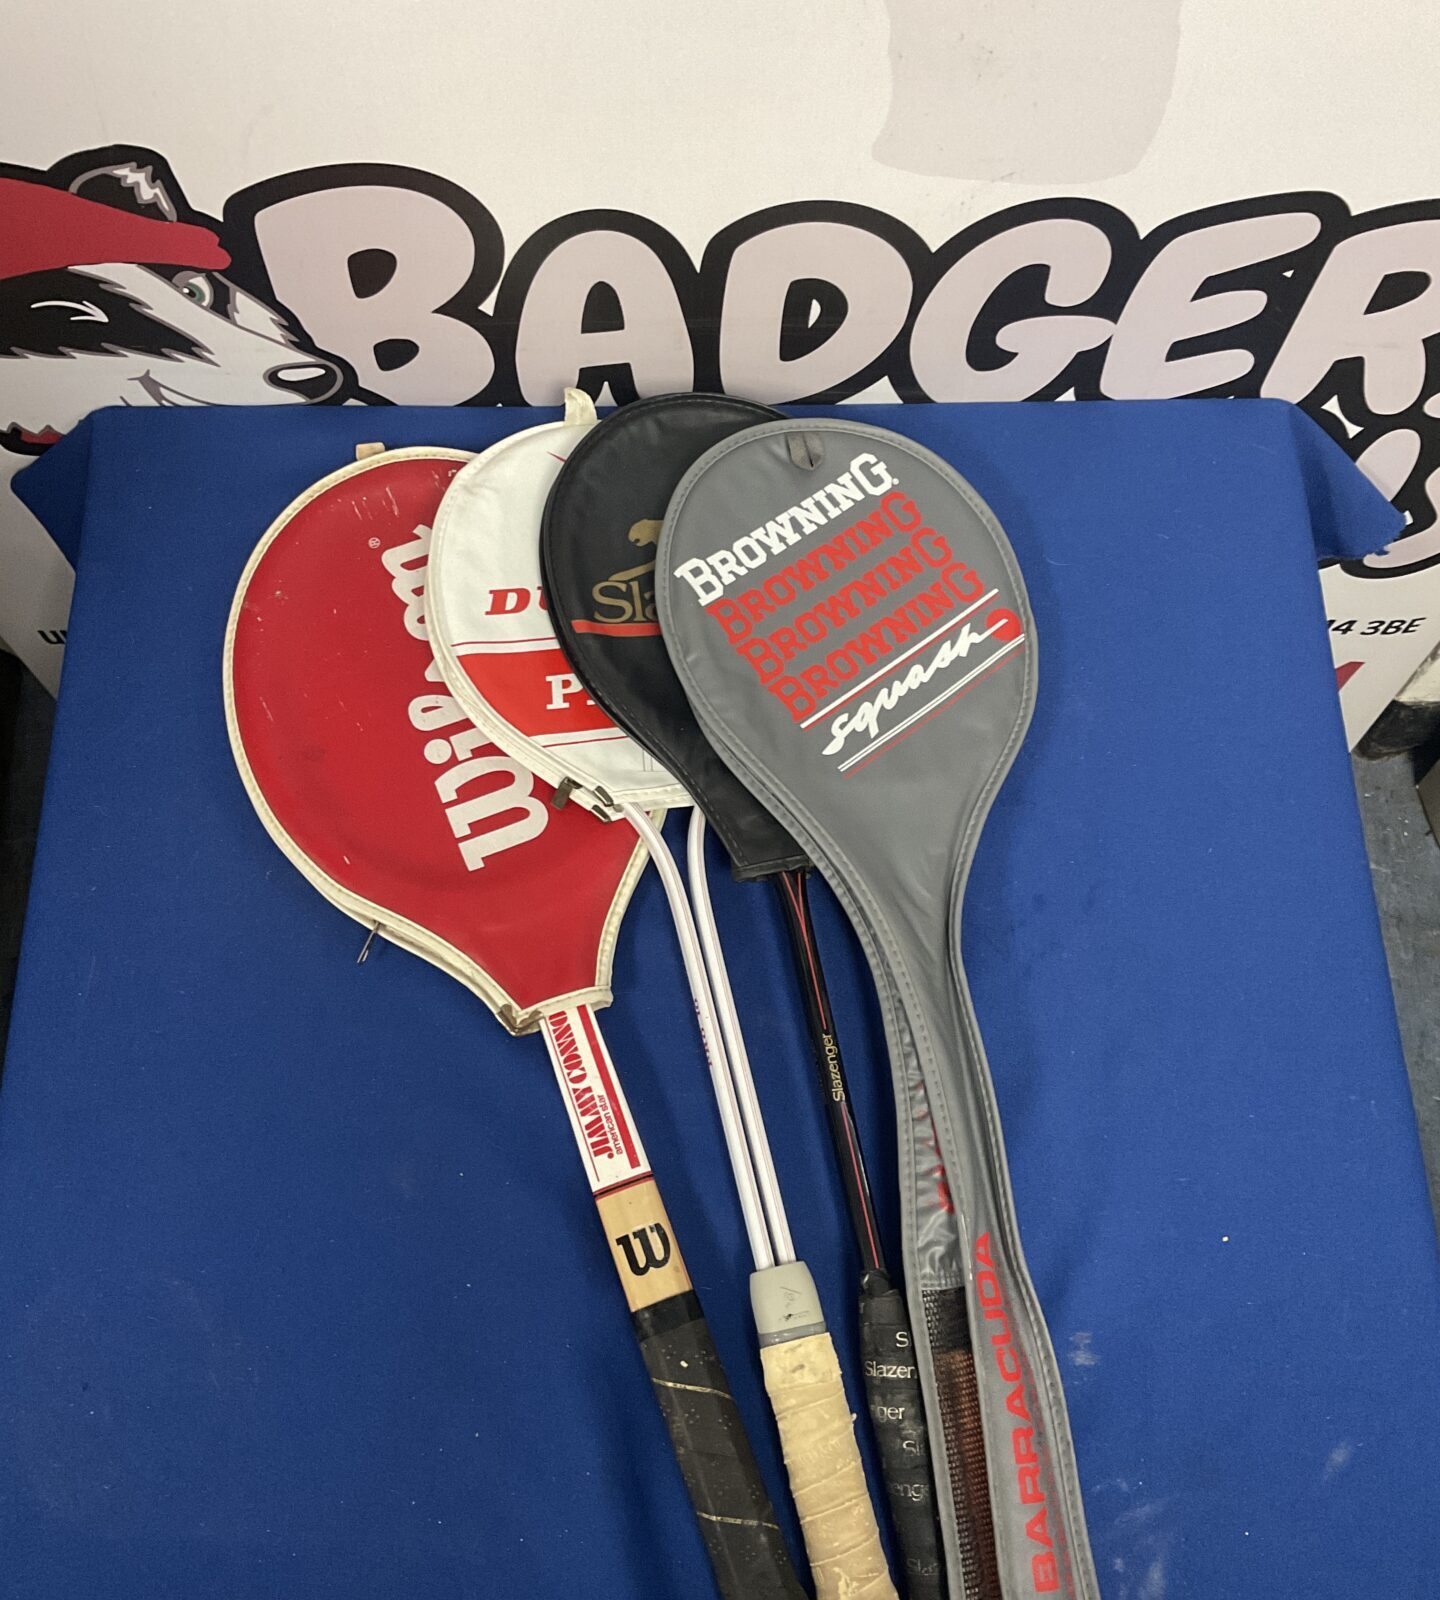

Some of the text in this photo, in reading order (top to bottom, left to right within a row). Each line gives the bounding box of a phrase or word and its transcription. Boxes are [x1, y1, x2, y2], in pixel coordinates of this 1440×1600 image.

[246, 175, 1440, 415] BADGER
[704, 491, 922, 644] BROWNING
[736, 527, 953, 685] BROWNING
[768, 562, 984, 722] BROWNING
[1360, 617, 1427, 636] 3BE
[381, 524, 549, 871] Wiln
[822, 618, 1008, 755] squash
[571, 1086, 615, 1160] JIMMY
[596, 1094, 623, 1155] american star
[822, 1033, 845, 1102] Slazenger
[975, 1231, 1061, 1593] BARRACUDA
